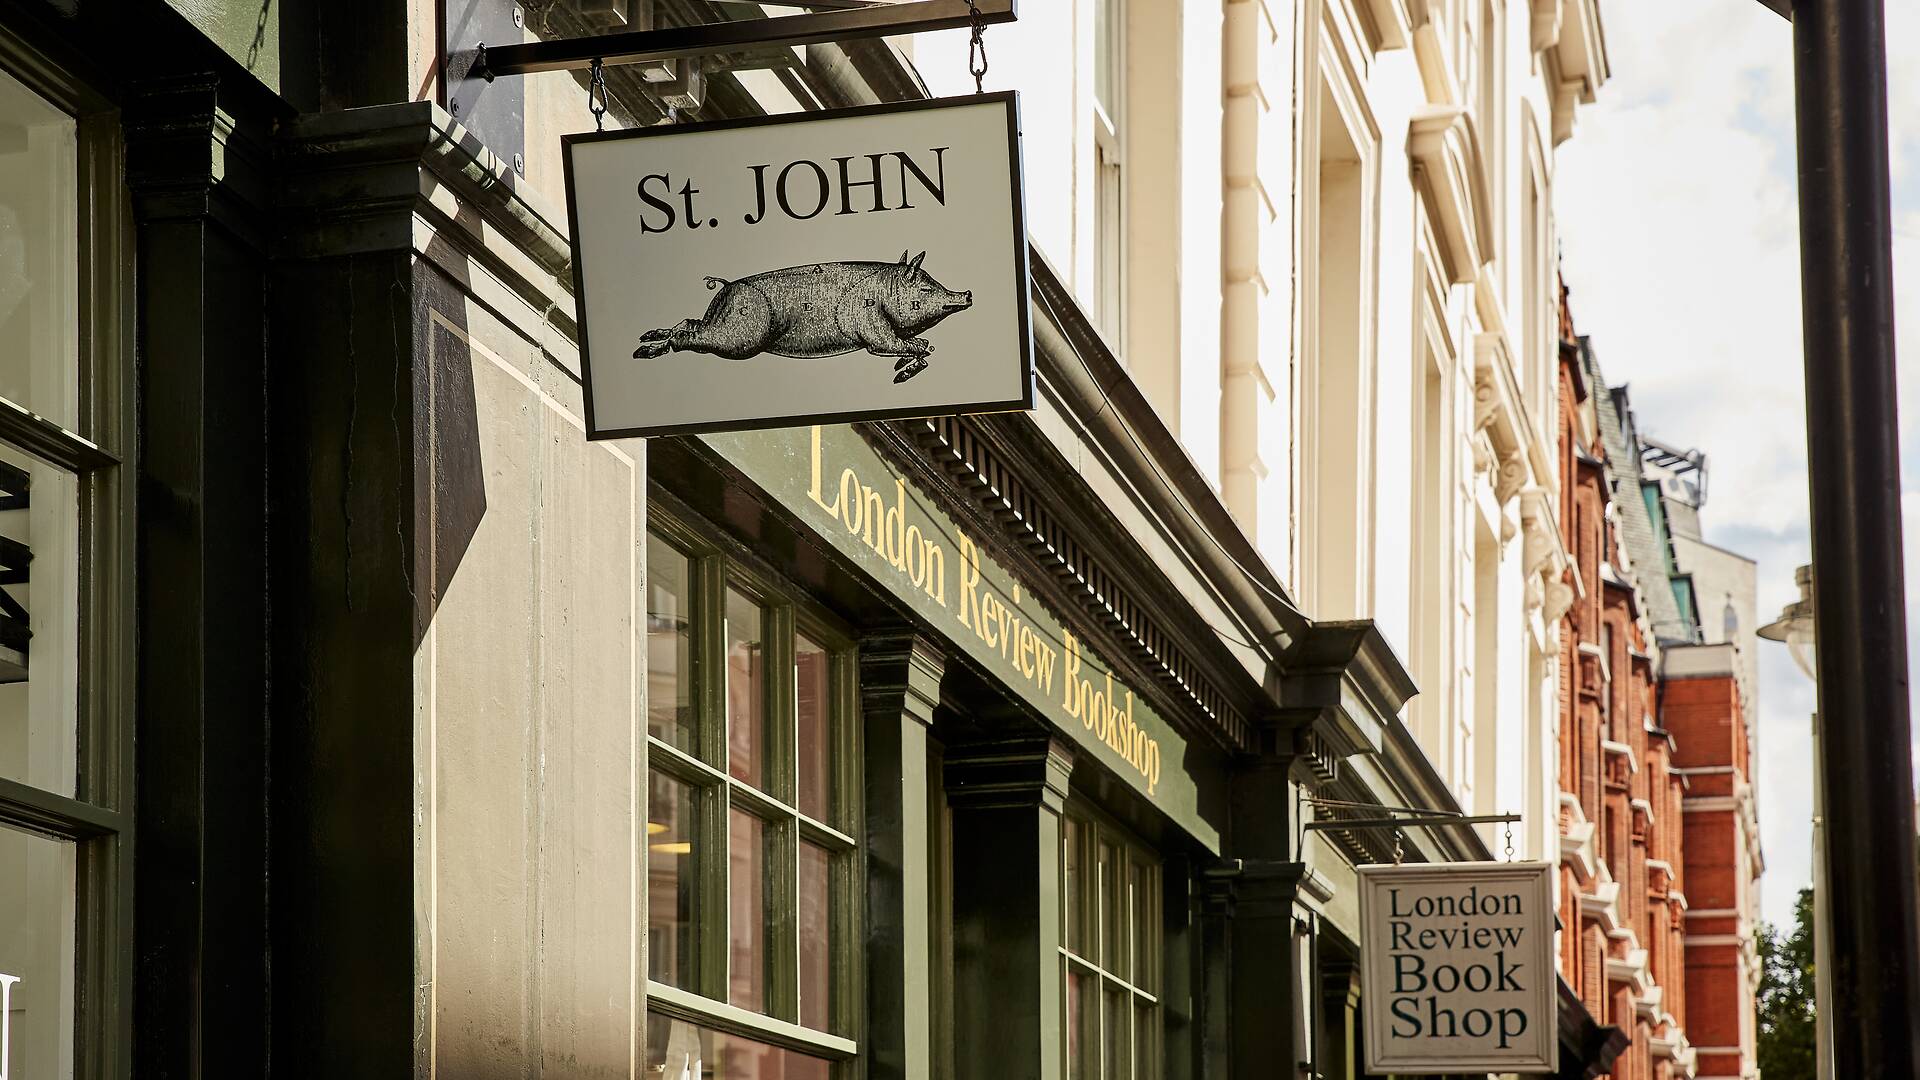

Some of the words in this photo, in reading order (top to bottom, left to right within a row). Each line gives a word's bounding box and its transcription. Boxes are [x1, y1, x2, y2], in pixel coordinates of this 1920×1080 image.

[636, 173, 719, 235] St.
[743, 147, 950, 225] JOHN
[812, 264, 824, 274] A
[806, 425, 947, 608] London
[956, 529, 1057, 697] Review
[1061, 629, 1161, 796] Bookshop
[1388, 886, 1523, 918] London
[1388, 921, 1524, 951] Review
[1390, 951, 1526, 994] Book
[1391, 996, 1528, 1049] Shop
